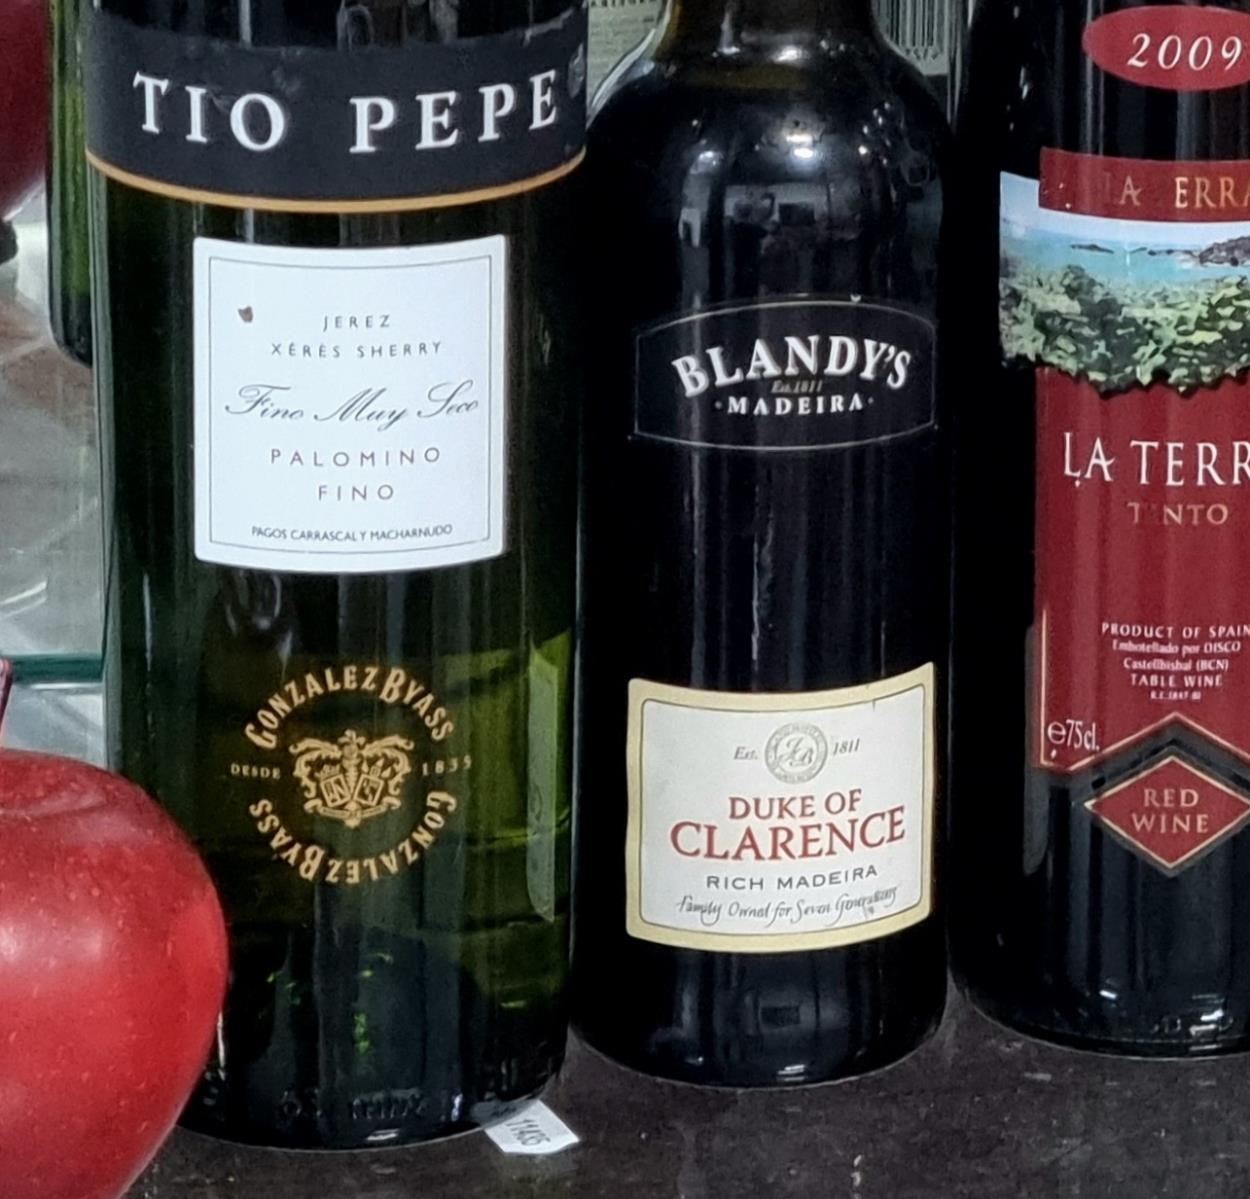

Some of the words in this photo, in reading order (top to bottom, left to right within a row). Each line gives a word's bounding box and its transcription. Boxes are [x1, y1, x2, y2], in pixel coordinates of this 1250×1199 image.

[1127, 32, 1244, 72] 2009
[133, 71, 286, 152] TIO
[349, 68, 557, 154] PEPE
[323, 314, 391, 332] JEREZ
[357, 341, 442, 358] SHERRY
[671, 334, 911, 398] BLANDY'S
[225, 384, 304, 420] Fino
[313, 387, 407, 431] Muy
[417, 379, 478, 418] Seco
[727, 392, 864, 415] MADEIRA
[271, 447, 440, 467] PALOMINO
[1063, 431, 1116, 483] LA
[318, 484, 393, 501] FINO
[1127, 502, 1229, 527] TNTO
[251, 525, 287, 539] PAGOS
[290, 528, 357, 542] CARRASCAL
[359, 531, 367, 542] Y
[370, 524, 453, 542] MACHARNUDO
[1101, 622, 1174, 638] PRODUCT
[1182, 626, 1201, 638] OF
[1130, 673, 1177, 688] TABLE
[1183, 674, 1223, 688] WINE
[244, 665, 380, 750] GONZALEZ
[379, 667, 455, 741] BYASS
[833, 737, 861, 756] 1811
[230, 763, 281, 779] DESDE
[728, 795, 816, 820] DUKE
[824, 788, 862, 815] OF
[1144, 788, 1199, 807] RED
[670, 805, 906, 862] CLARENCE
[1131, 813, 1209, 833] WINE
[706, 875, 764, 891] RICH
[777, 864, 878, 890] MADEIRA
[675, 895, 722, 927] Family
[765, 900, 791, 928] for
[790, 898, 830, 924] Seven
